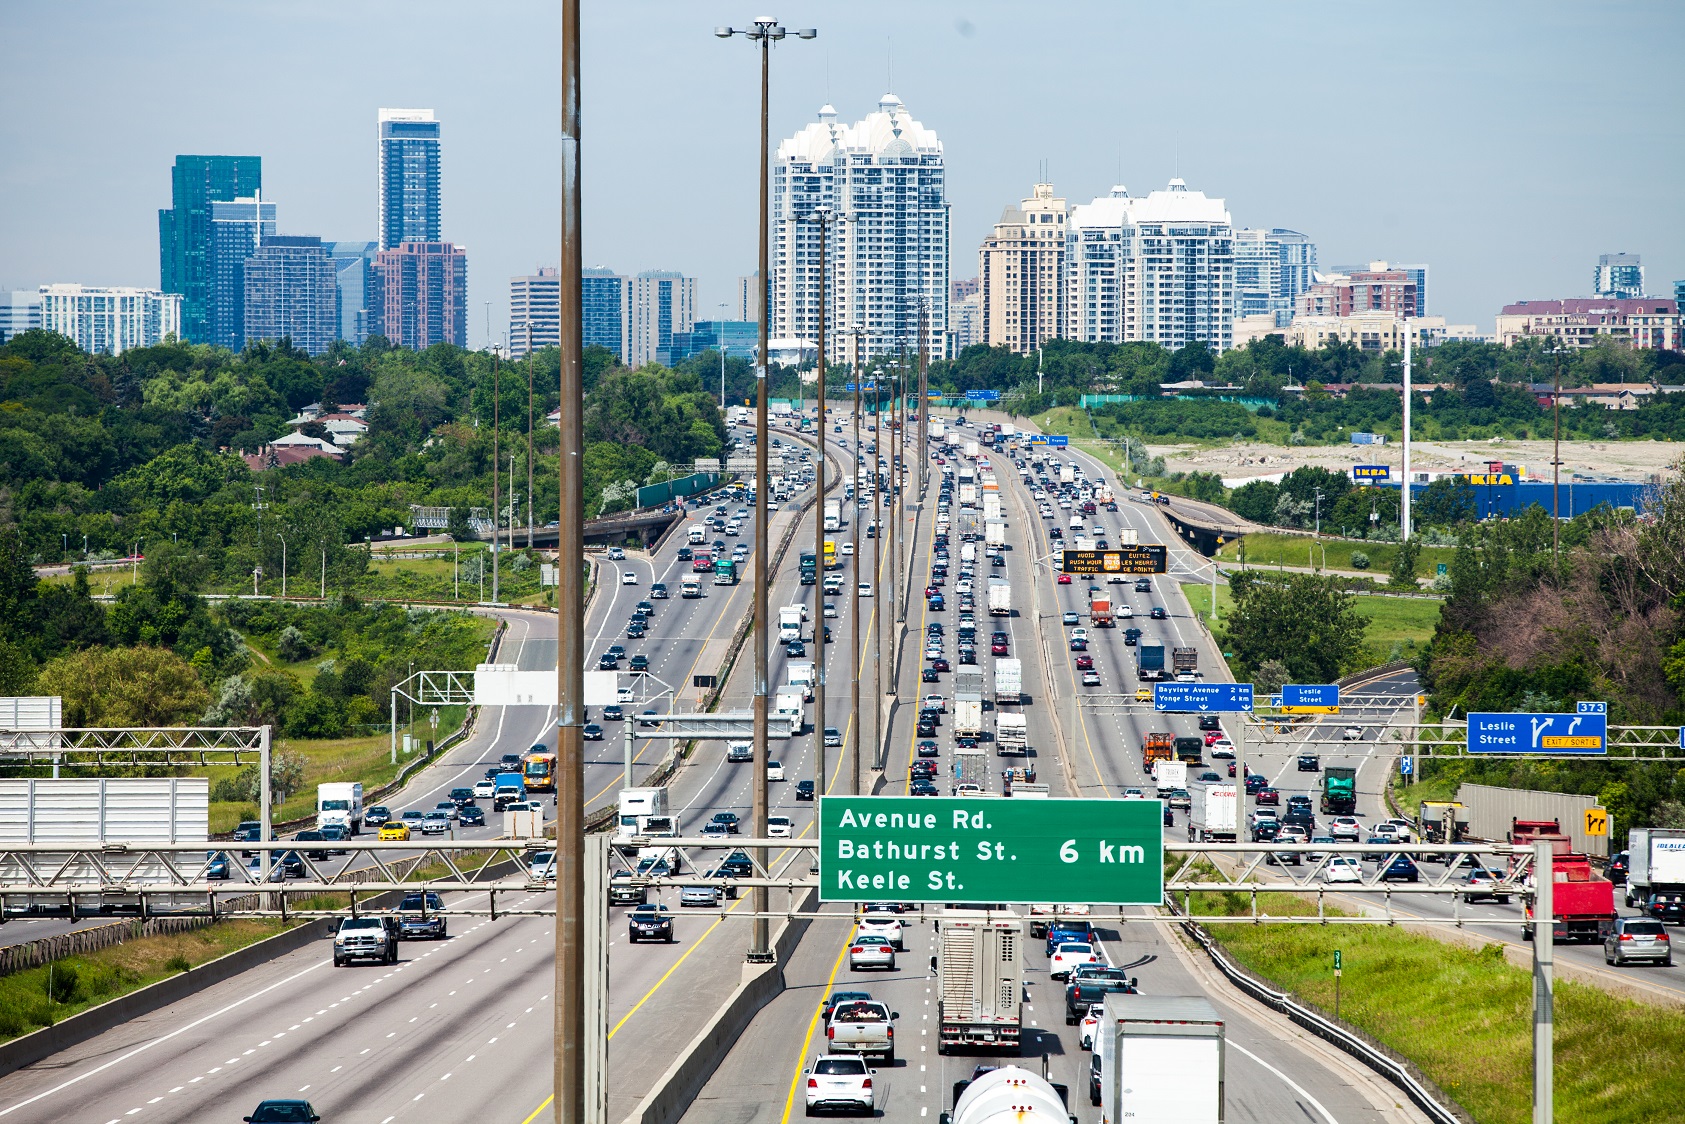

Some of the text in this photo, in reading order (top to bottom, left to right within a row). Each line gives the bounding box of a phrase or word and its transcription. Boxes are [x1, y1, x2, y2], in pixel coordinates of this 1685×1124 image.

[1356, 468, 1387, 476] IKEA
[1580, 704, 1604, 712] 373
[1480, 722, 1516, 730] Leslie
[1480, 734, 1516, 744] Street
[1402, 756, 1410, 766] H
[839, 808, 993, 829] Avenue Rd.
[838, 839, 1145, 863] Bathurst St. 6 km
[838, 870, 964, 890] Keele St.
